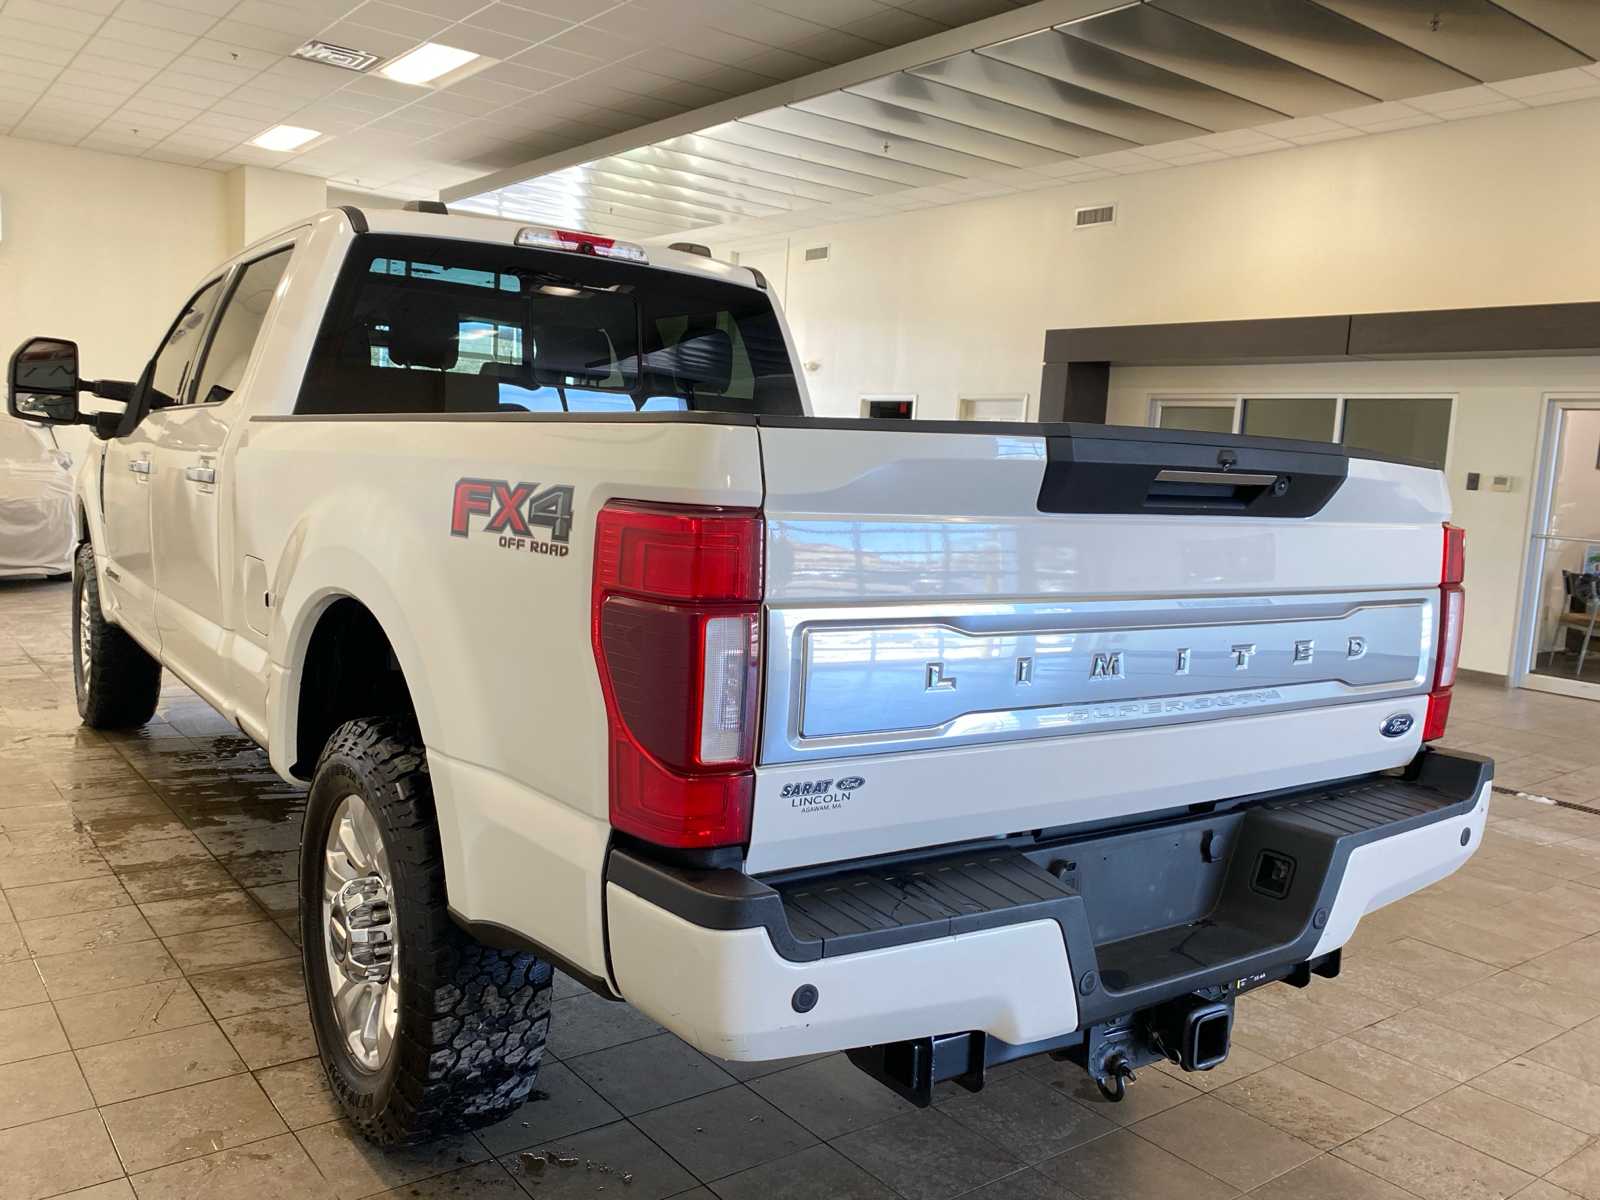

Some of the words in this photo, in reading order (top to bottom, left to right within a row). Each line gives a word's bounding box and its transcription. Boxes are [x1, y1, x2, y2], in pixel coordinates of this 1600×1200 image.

[451, 477, 575, 544] FX4
[499, 536, 525, 550] OFF
[530, 540, 570, 557] ROAD
[925, 636, 1368, 693] LIMITED
[1067, 700, 1185, 721] SUPER
[1194, 691, 1273, 710] DUTY
[780, 779, 834, 798] SARAT
[791, 792, 851, 807] LINCOLN
[801, 804, 831, 813] AGAWAM,
